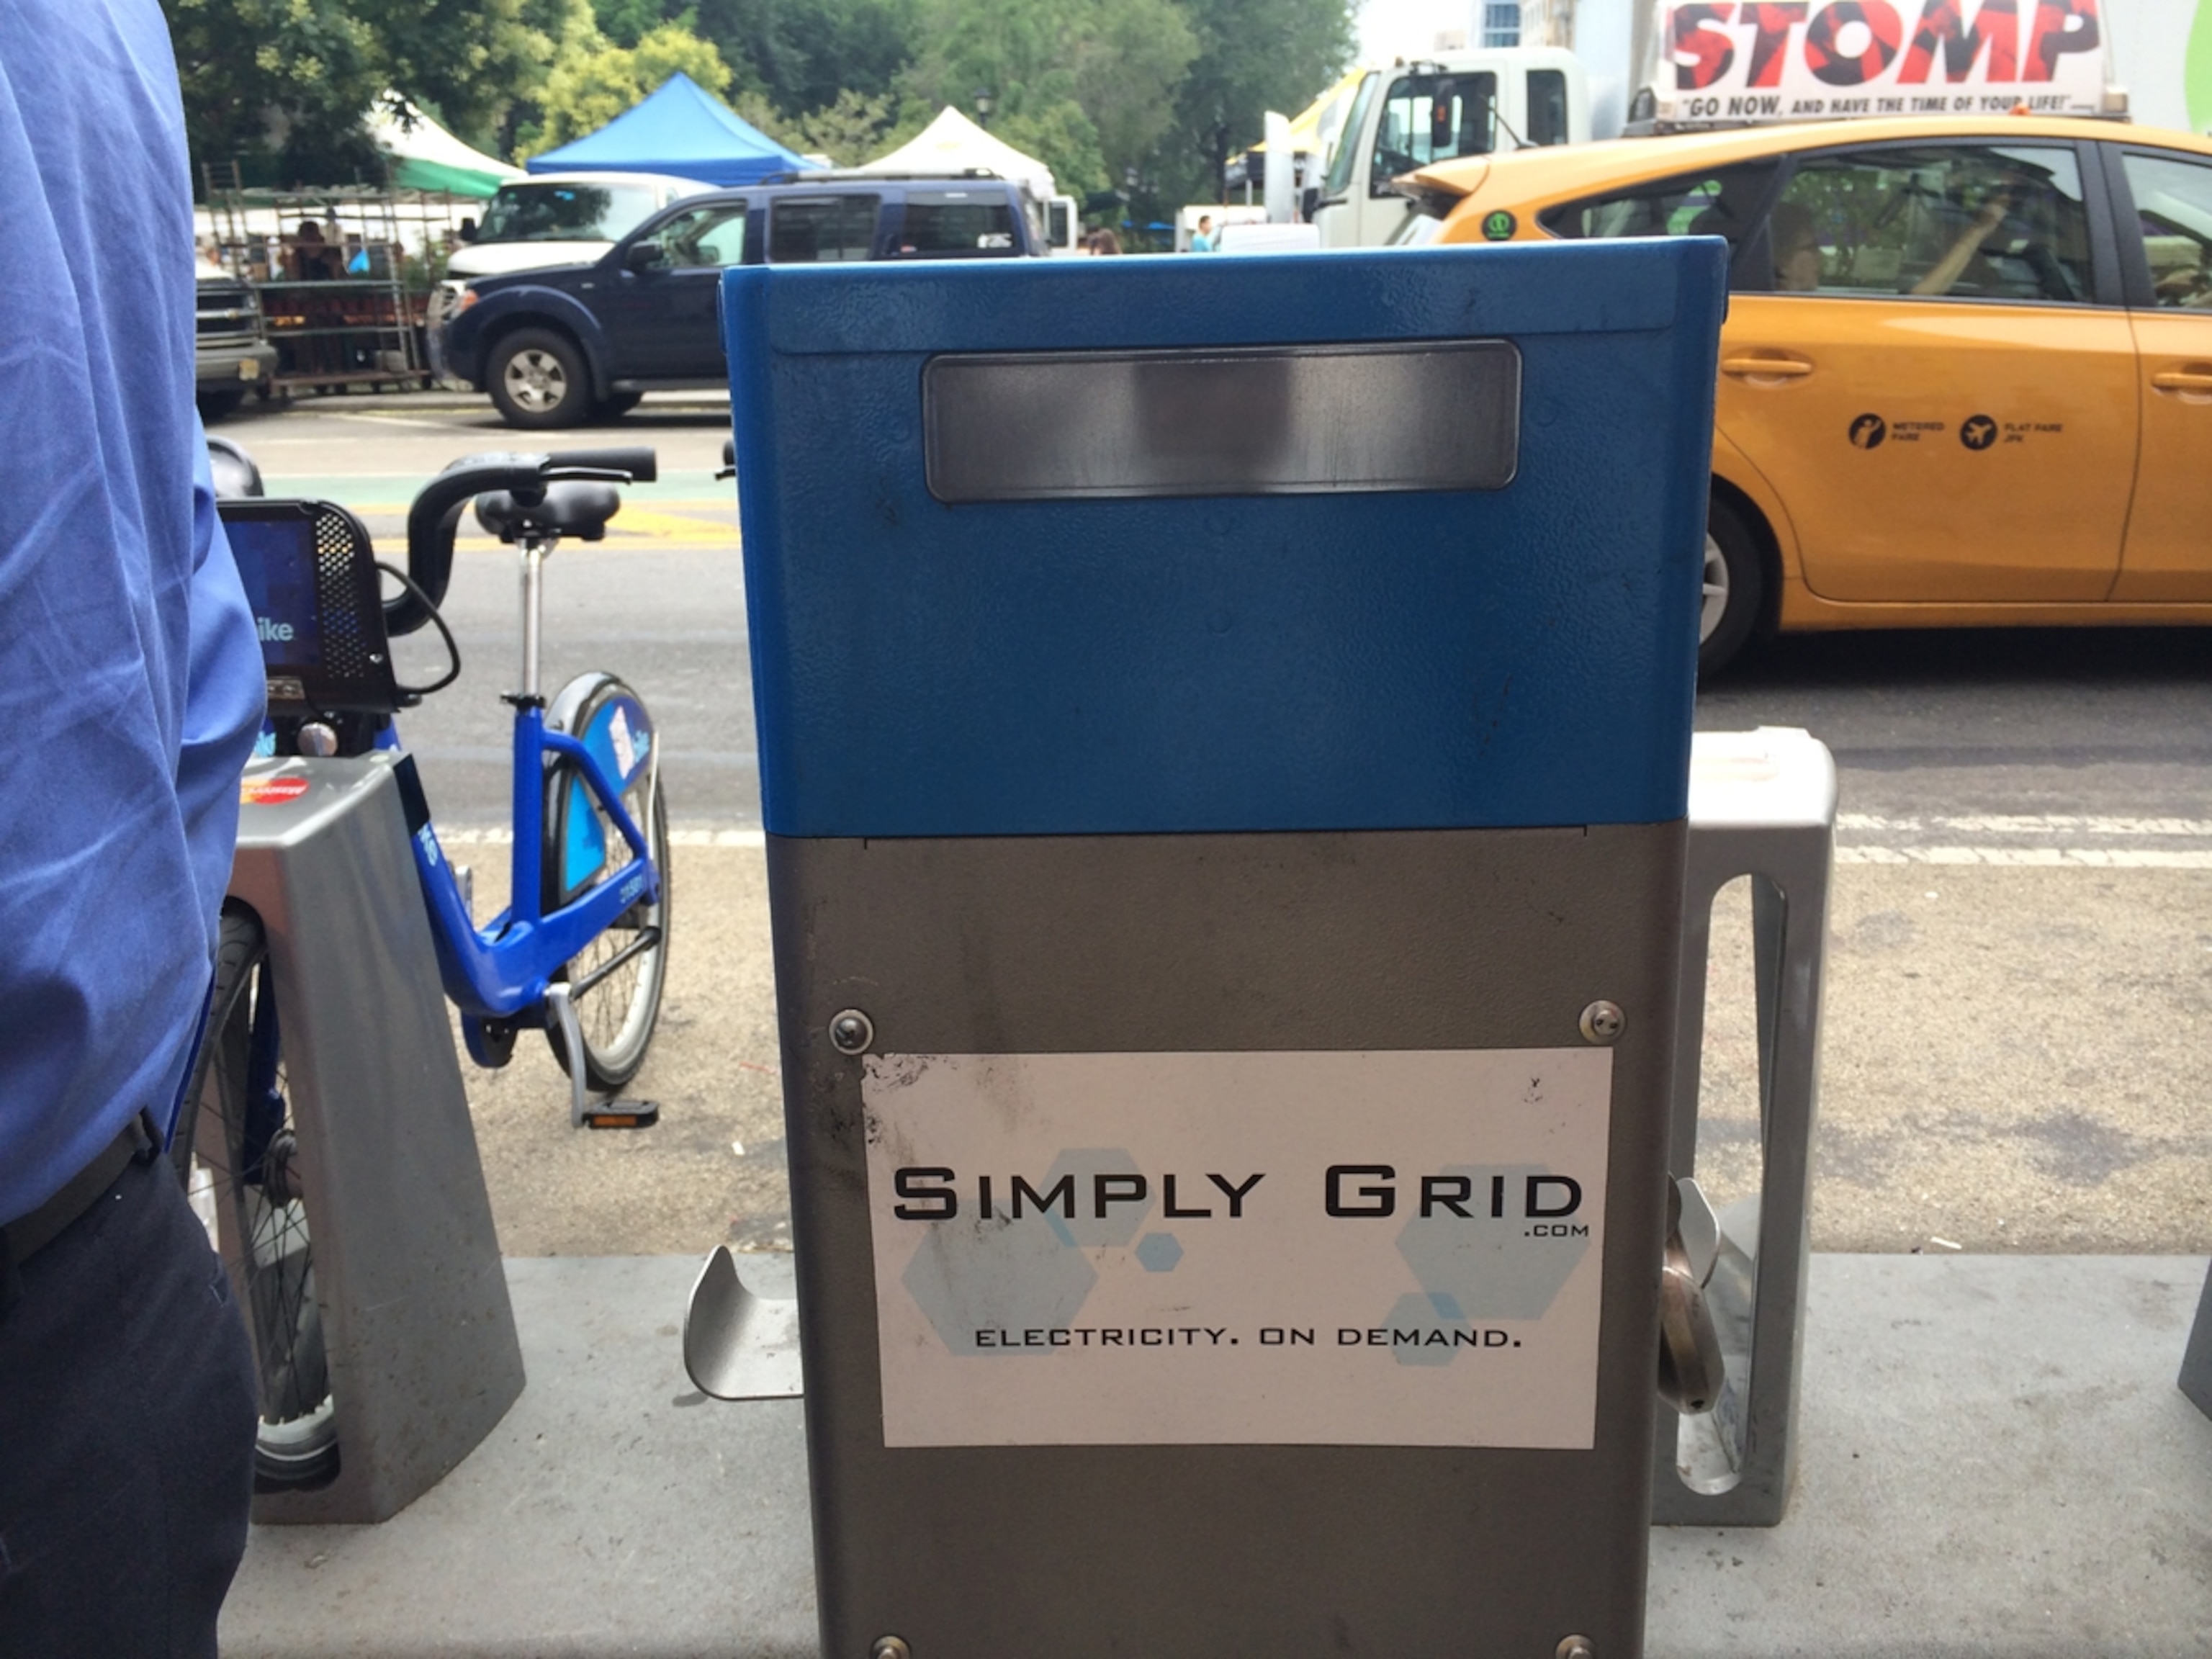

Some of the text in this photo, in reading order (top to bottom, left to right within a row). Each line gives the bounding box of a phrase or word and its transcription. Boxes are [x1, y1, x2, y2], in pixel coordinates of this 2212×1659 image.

[1668, 0, 2100, 90] STOMP
[1791, 99, 1825, 114] AND
[1830, 98, 1870, 113] HAVE
[1877, 97, 1905, 112] THE
[1911, 96, 1948, 111] TIME
[1954, 96, 1974, 110] OF
[894, 1165, 1582, 1220] SIMPLY GRID
[975, 1328, 1521, 1349] ELECTRICITY. ON DEMAND.
